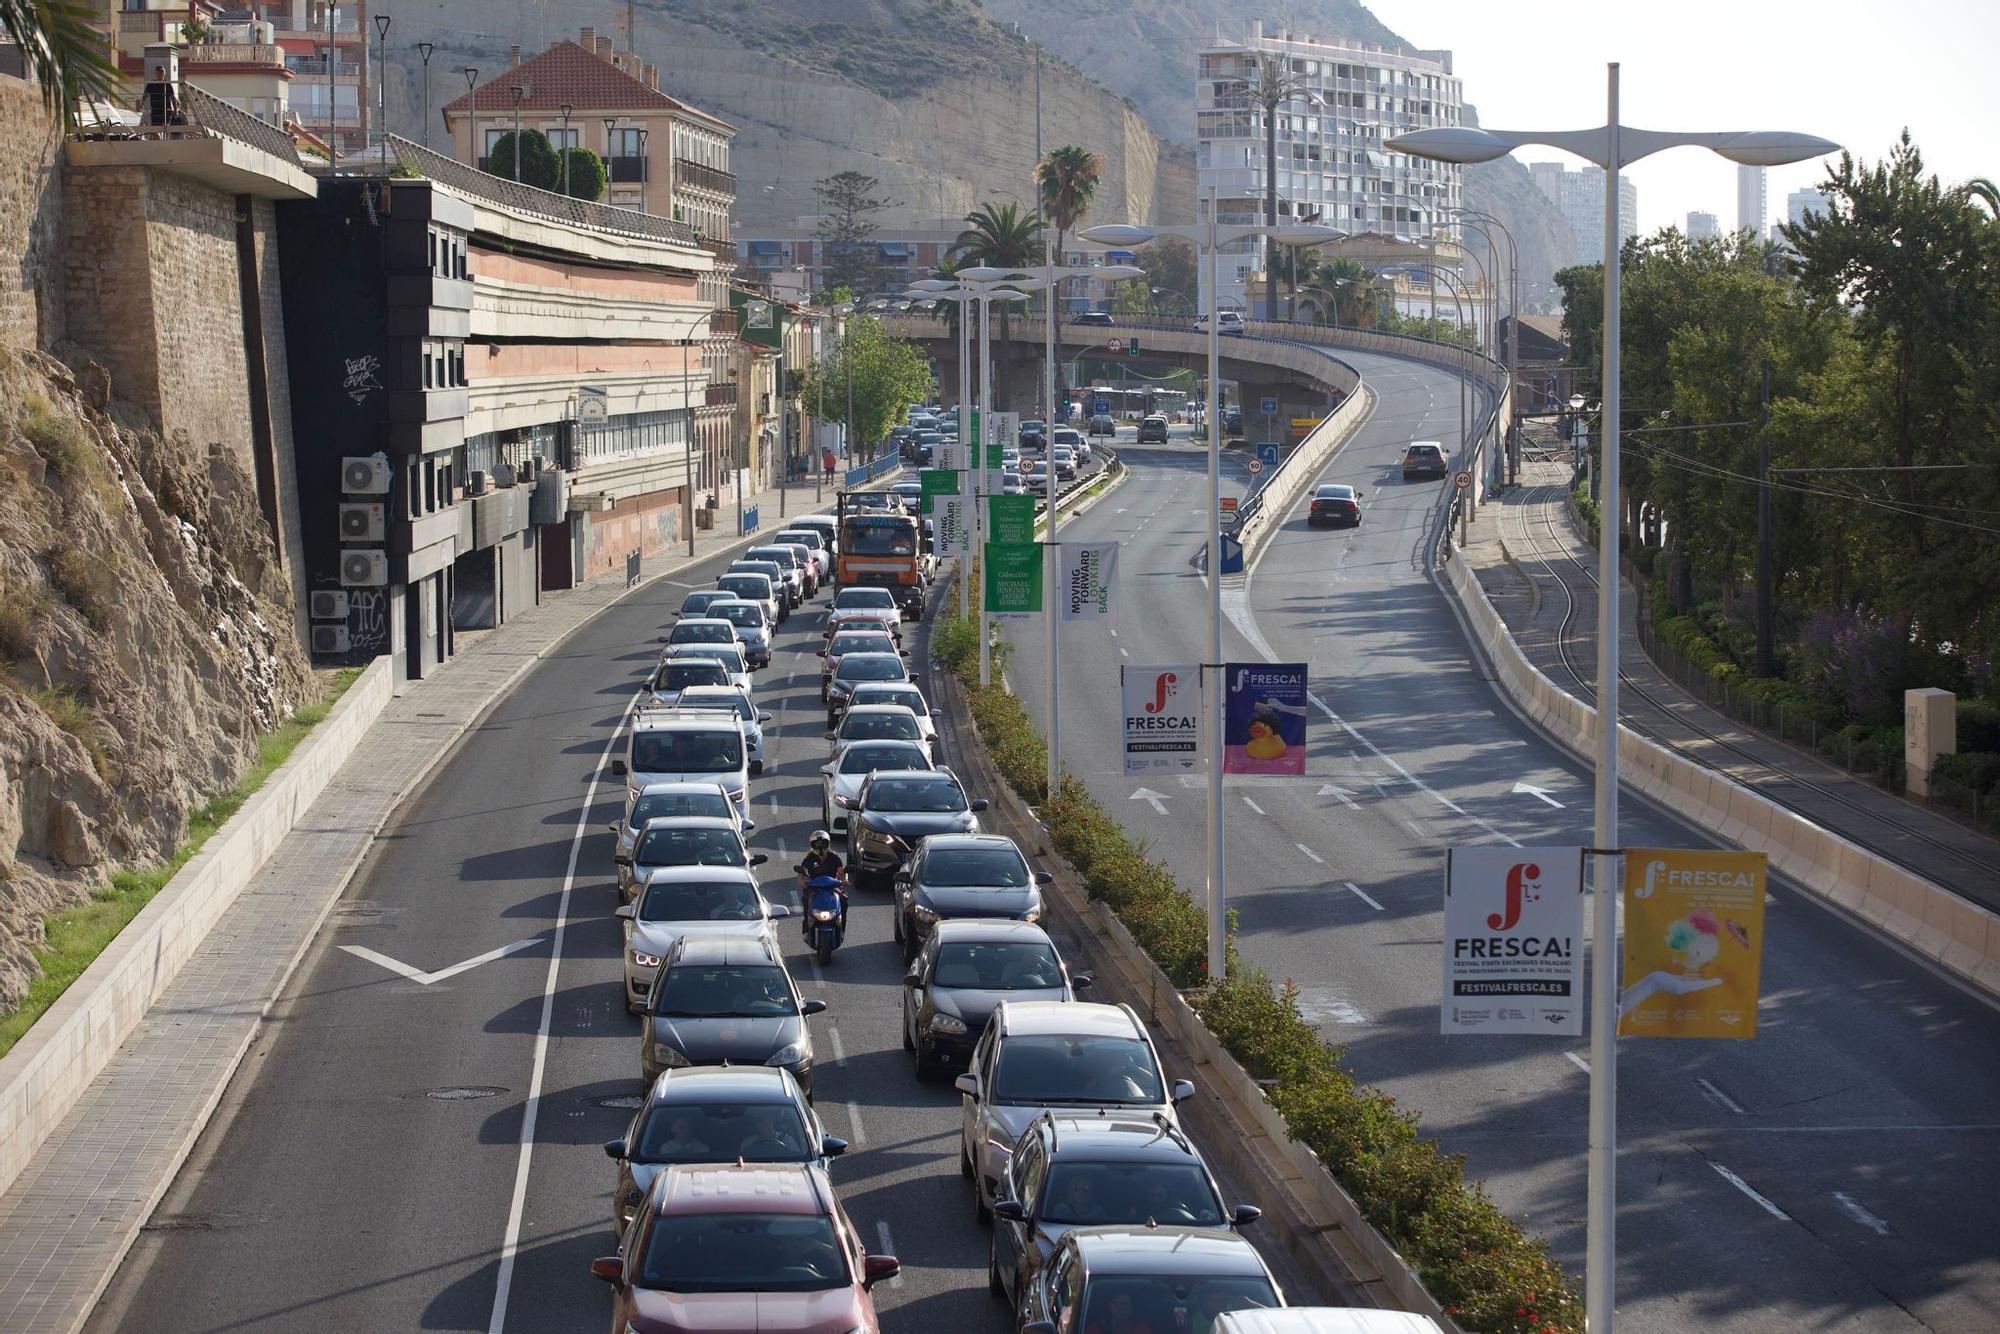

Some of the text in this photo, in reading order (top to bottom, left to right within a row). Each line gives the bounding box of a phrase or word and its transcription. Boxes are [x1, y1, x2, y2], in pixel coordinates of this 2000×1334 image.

[1081, 551, 1089, 603] FORWARD
[1090, 551, 1099, 603] LOOKING
[1072, 569, 1080, 613] MOVING
[1099, 586, 1108, 613] BACK
[1251, 674, 1301, 684] FRESCA!
[1126, 716, 1196, 730] FRESCA!
[1668, 870, 1755, 888] FRESCA!
[1454, 937, 1572, 958] FRESCA!
[1461, 983, 1563, 993] FESTIVALFRESCA.ES
